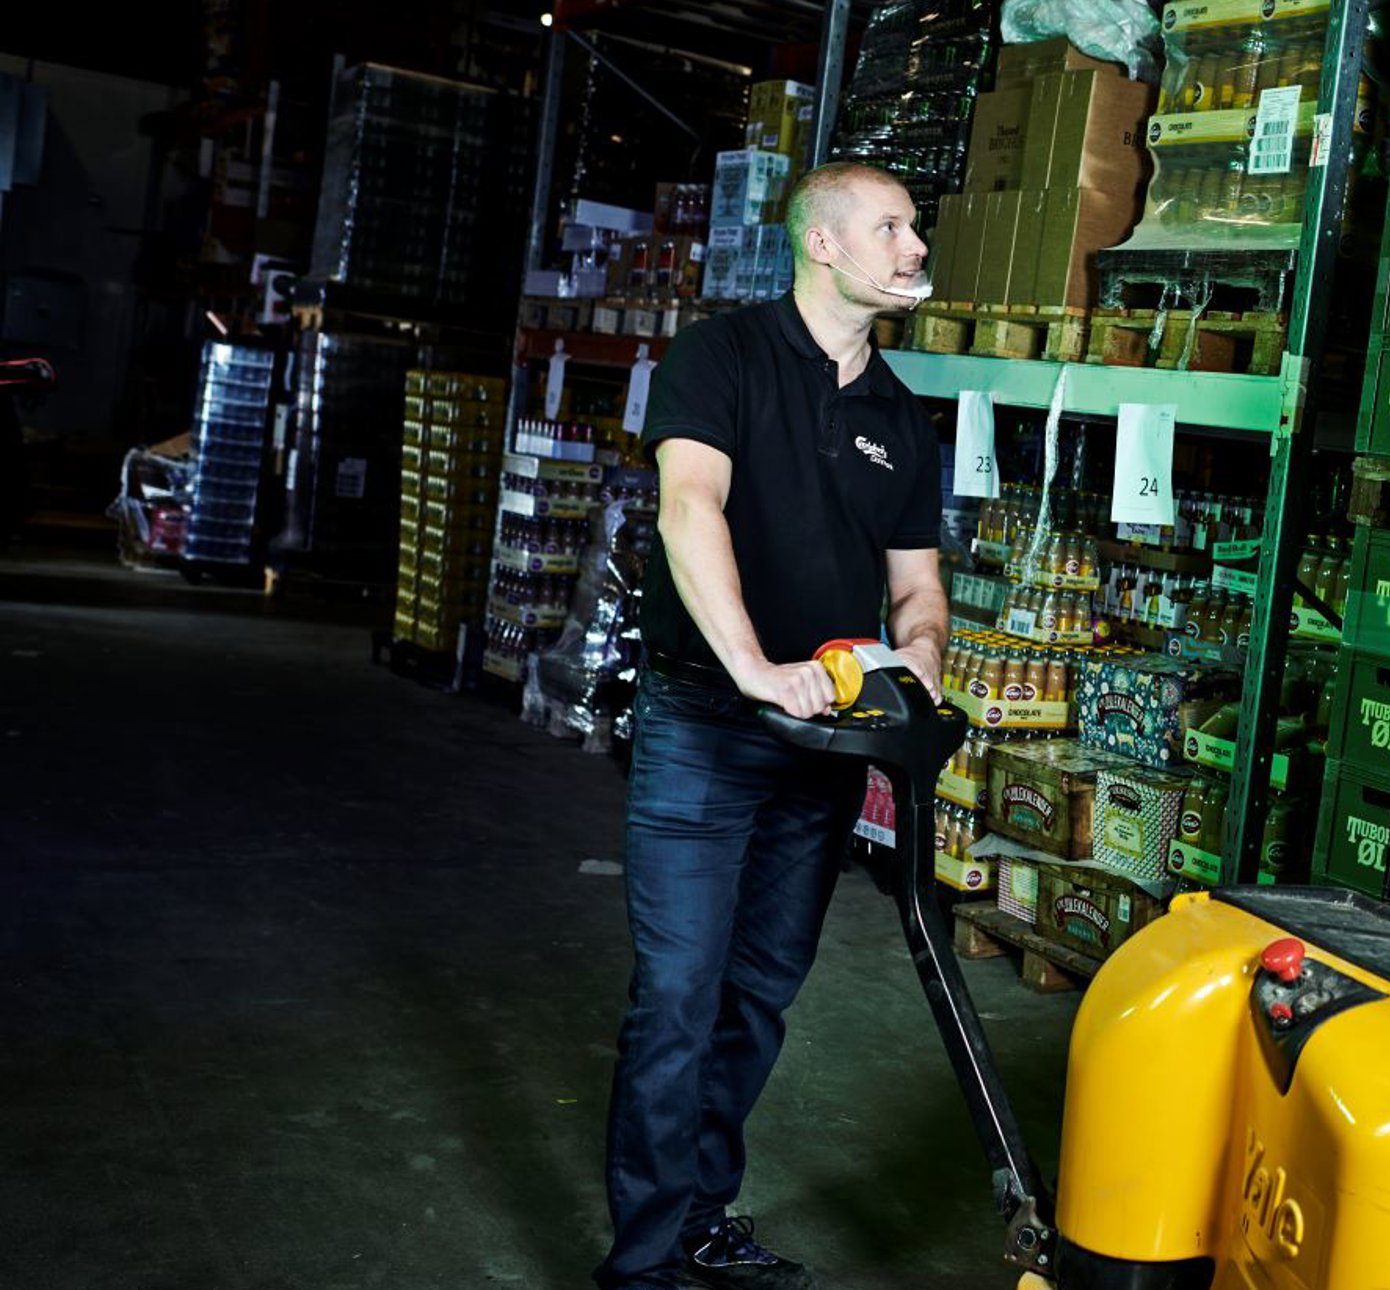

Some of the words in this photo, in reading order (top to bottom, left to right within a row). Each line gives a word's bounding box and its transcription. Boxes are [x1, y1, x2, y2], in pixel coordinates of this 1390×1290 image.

[976, 456, 992, 474] 23
[1139, 477, 1159, 498] 24
[1008, 708, 1042, 717] CHOCOLATE
[1346, 816, 1390, 843] TUBO
[1243, 1127, 1304, 1260] Yale
